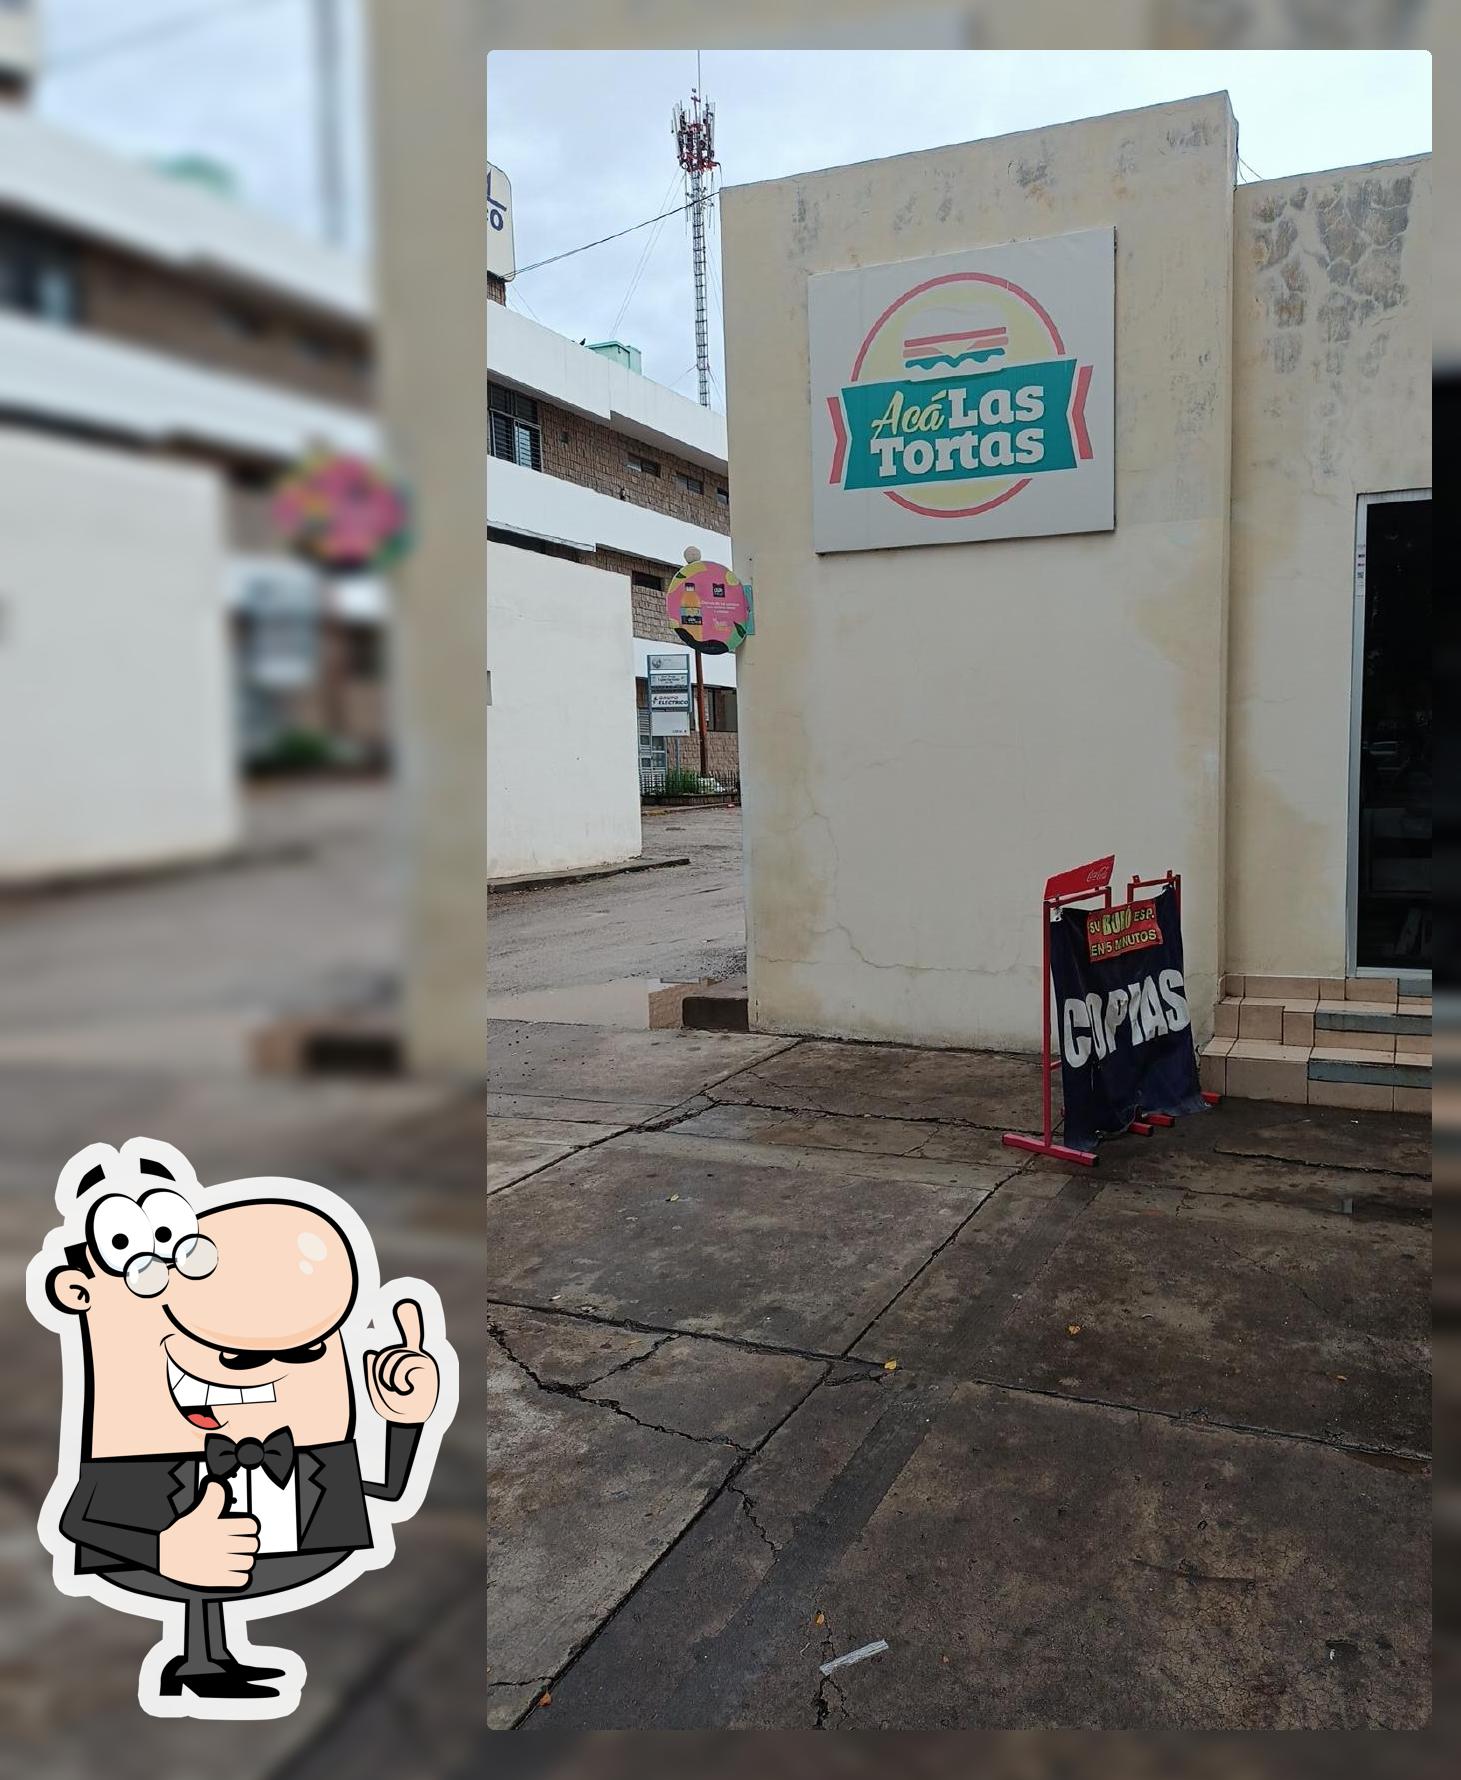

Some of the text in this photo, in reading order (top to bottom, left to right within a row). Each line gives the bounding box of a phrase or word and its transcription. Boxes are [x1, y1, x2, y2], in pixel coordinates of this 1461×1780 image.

[871, 385, 1045, 440] Acá Las
[870, 428, 1045, 477] Tortas
[1089, 921, 1100, 934] SU
[1134, 908, 1155, 922] ESP.
[1091, 943, 1105, 956] EN
[1106, 941, 1113, 953] 5
[1063, 968, 1191, 1069] COPIAS
